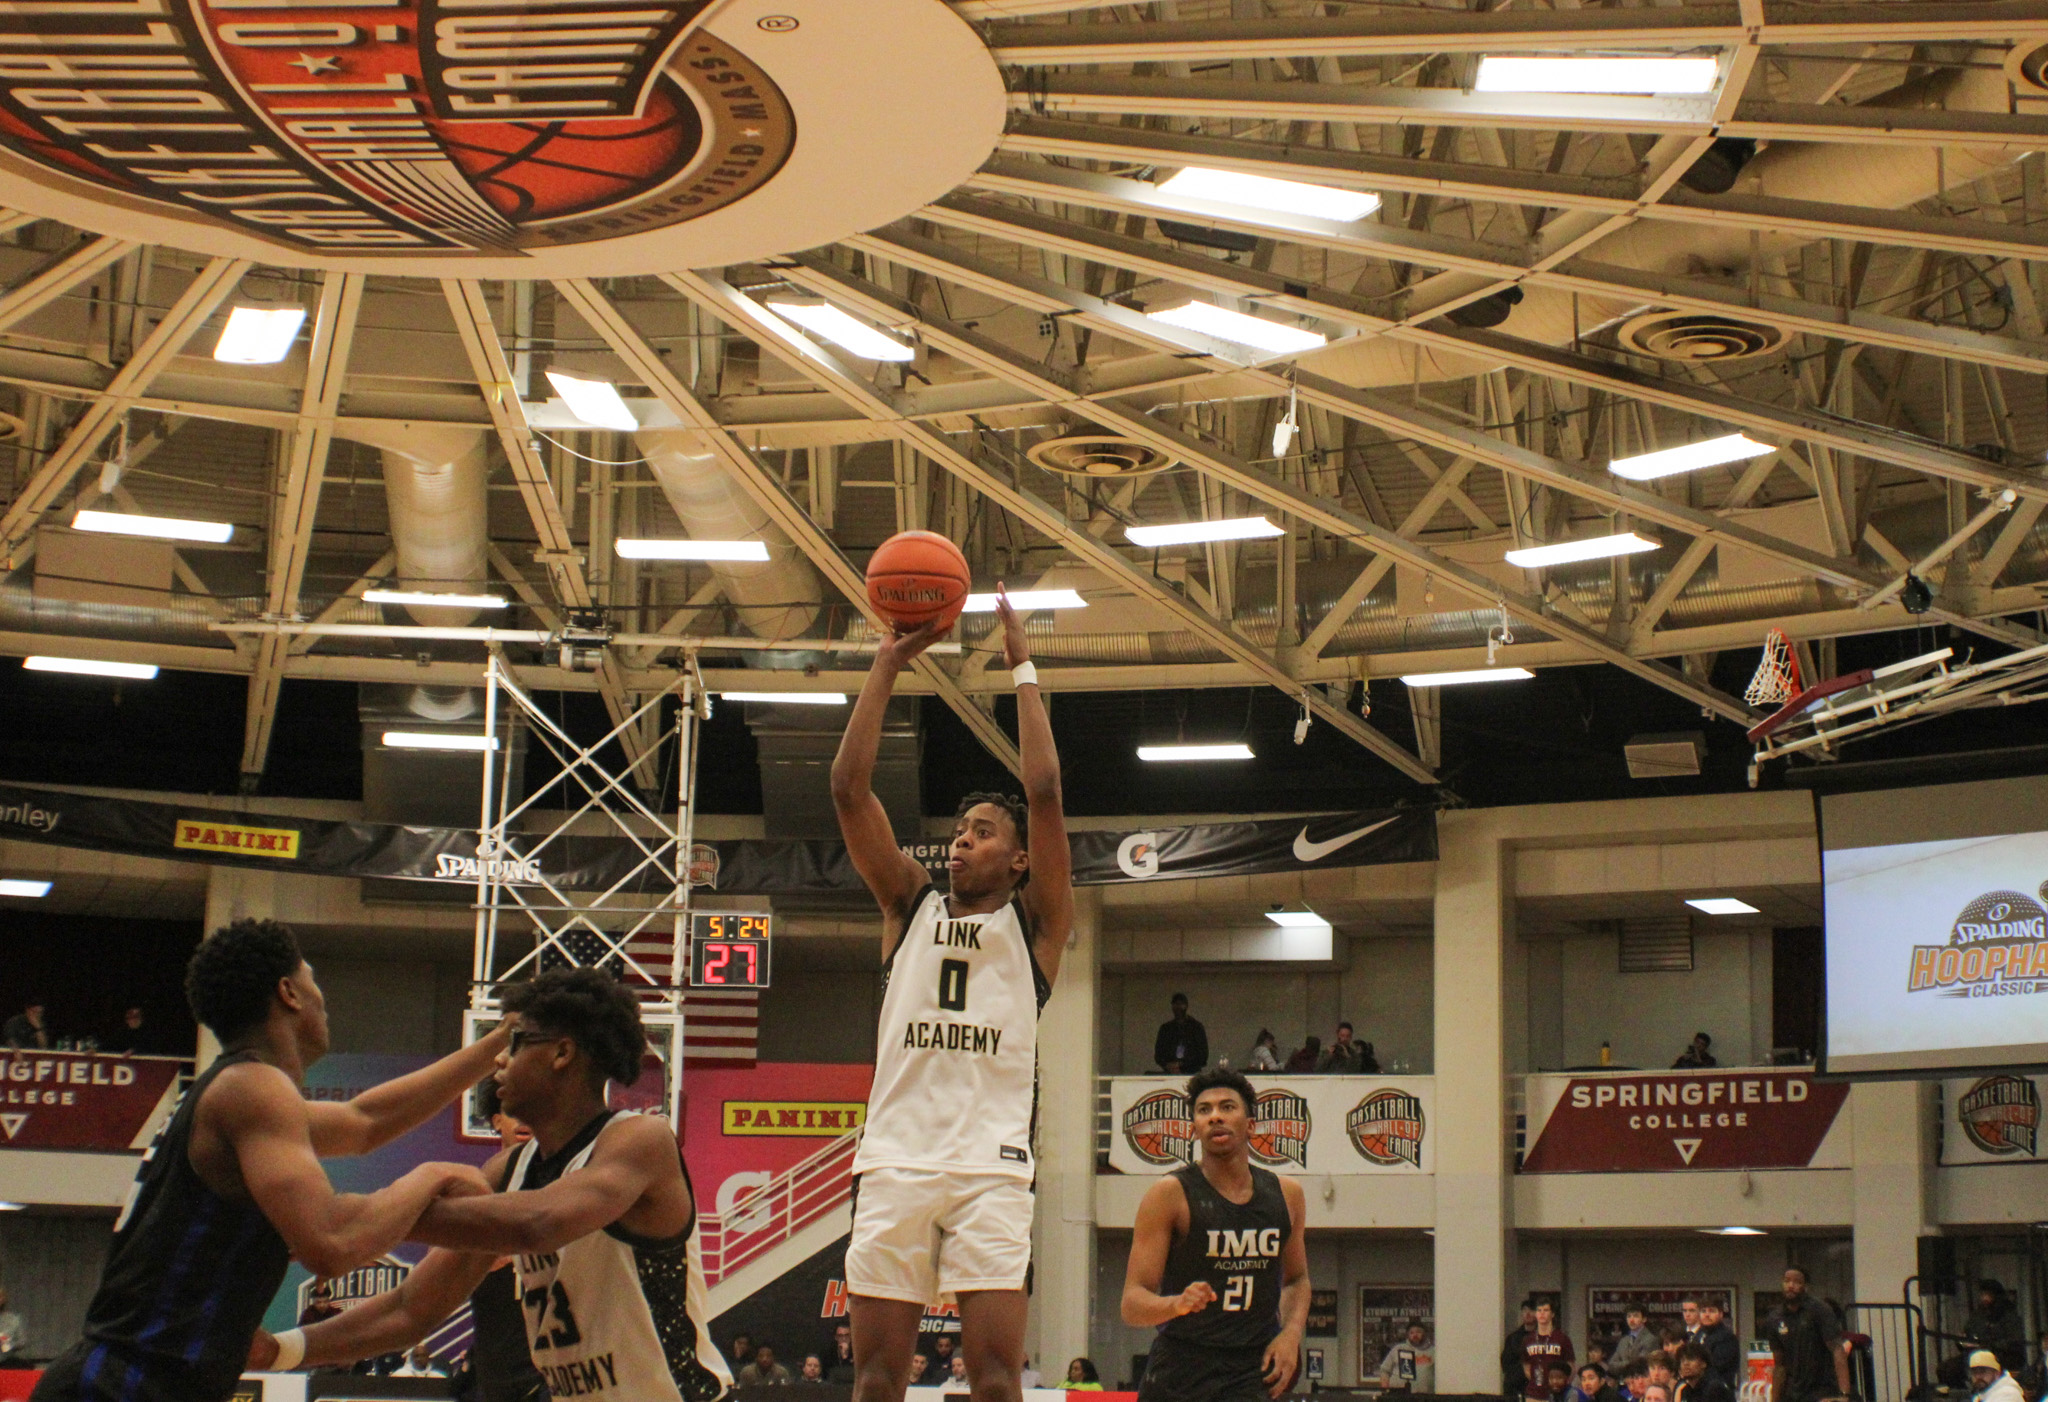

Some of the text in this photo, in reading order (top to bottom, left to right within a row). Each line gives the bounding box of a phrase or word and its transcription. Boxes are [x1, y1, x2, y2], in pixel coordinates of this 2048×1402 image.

[877, 586, 945, 603] SPALDING
[182, 826, 291, 851] PANINI
[1117, 833, 1159, 878] G
[709, 916, 769, 938] 5:24
[934, 921, 984, 949] LINK
[1955, 916, 2045, 944] SPALDING
[704, 944, 757, 984] 27
[938, 958, 969, 1012] 0
[1972, 981, 2034, 998] CLASSIC
[904, 1022, 1002, 1055] ACADEMY
[0, 1090, 76, 1106] LEGE
[1571, 1080, 1808, 1109] SPRINGFIELD
[1963, 1081, 2033, 1113] BASKETBALL
[732, 1109, 857, 1128] PANINI
[1127, 1098, 1192, 1127] BASKETBALL
[1257, 1098, 1304, 1121] KETBALL
[1351, 1098, 1417, 1128] BASKETBALL
[1629, 1113, 1748, 1130] COLLEGE
[1163, 1136, 1191, 1165] FAME
[1275, 1136, 1304, 1165] FAME
[1388, 1136, 1418, 1165] FAME
[2004, 1123, 2034, 1152] FAME
[1205, 1228, 1280, 1258] IMG
[1214, 1260, 1269, 1271] ACADEMY
[1222, 1275, 1254, 1312] 21
[524, 1279, 582, 1351] 23
